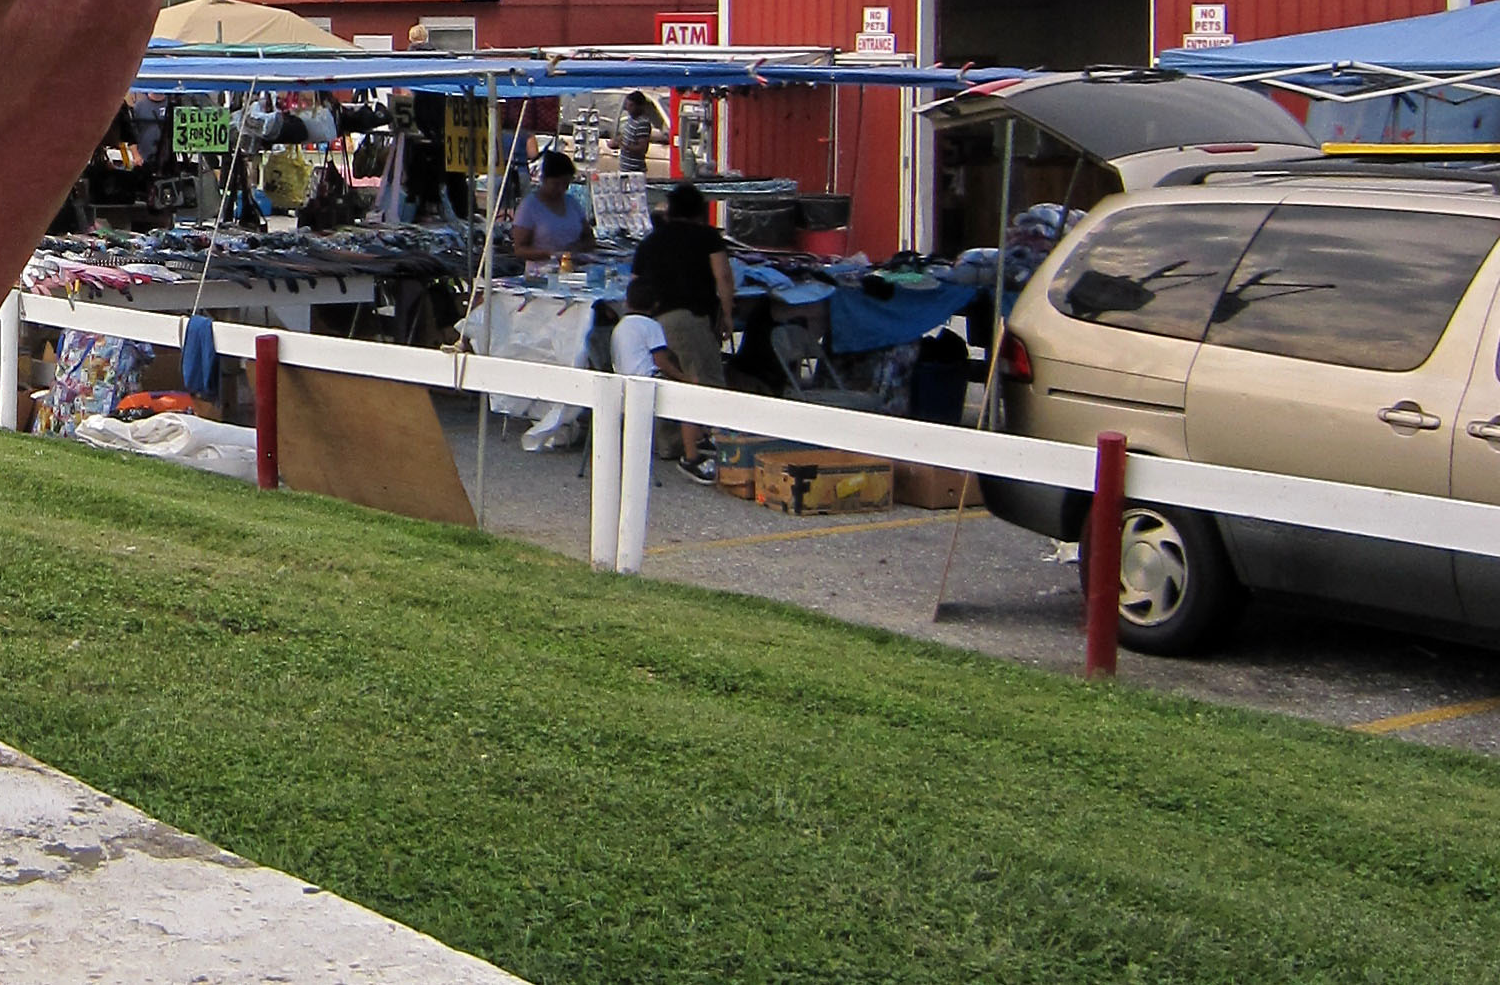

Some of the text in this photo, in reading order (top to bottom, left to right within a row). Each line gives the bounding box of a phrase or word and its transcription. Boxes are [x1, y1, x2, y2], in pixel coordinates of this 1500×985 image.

[869, 11, 882, 20] NO
[1201, 8, 1216, 19] NO
[865, 21, 886, 31] PETS
[1194, 21, 1222, 31] PETS
[655, 25, 707, 45] ATM
[858, 37, 892, 51] ENTRANCE
[180, 111, 219, 124] BELTS
[176, 126, 188, 146] 3
[204, 123, 228, 146] $10
